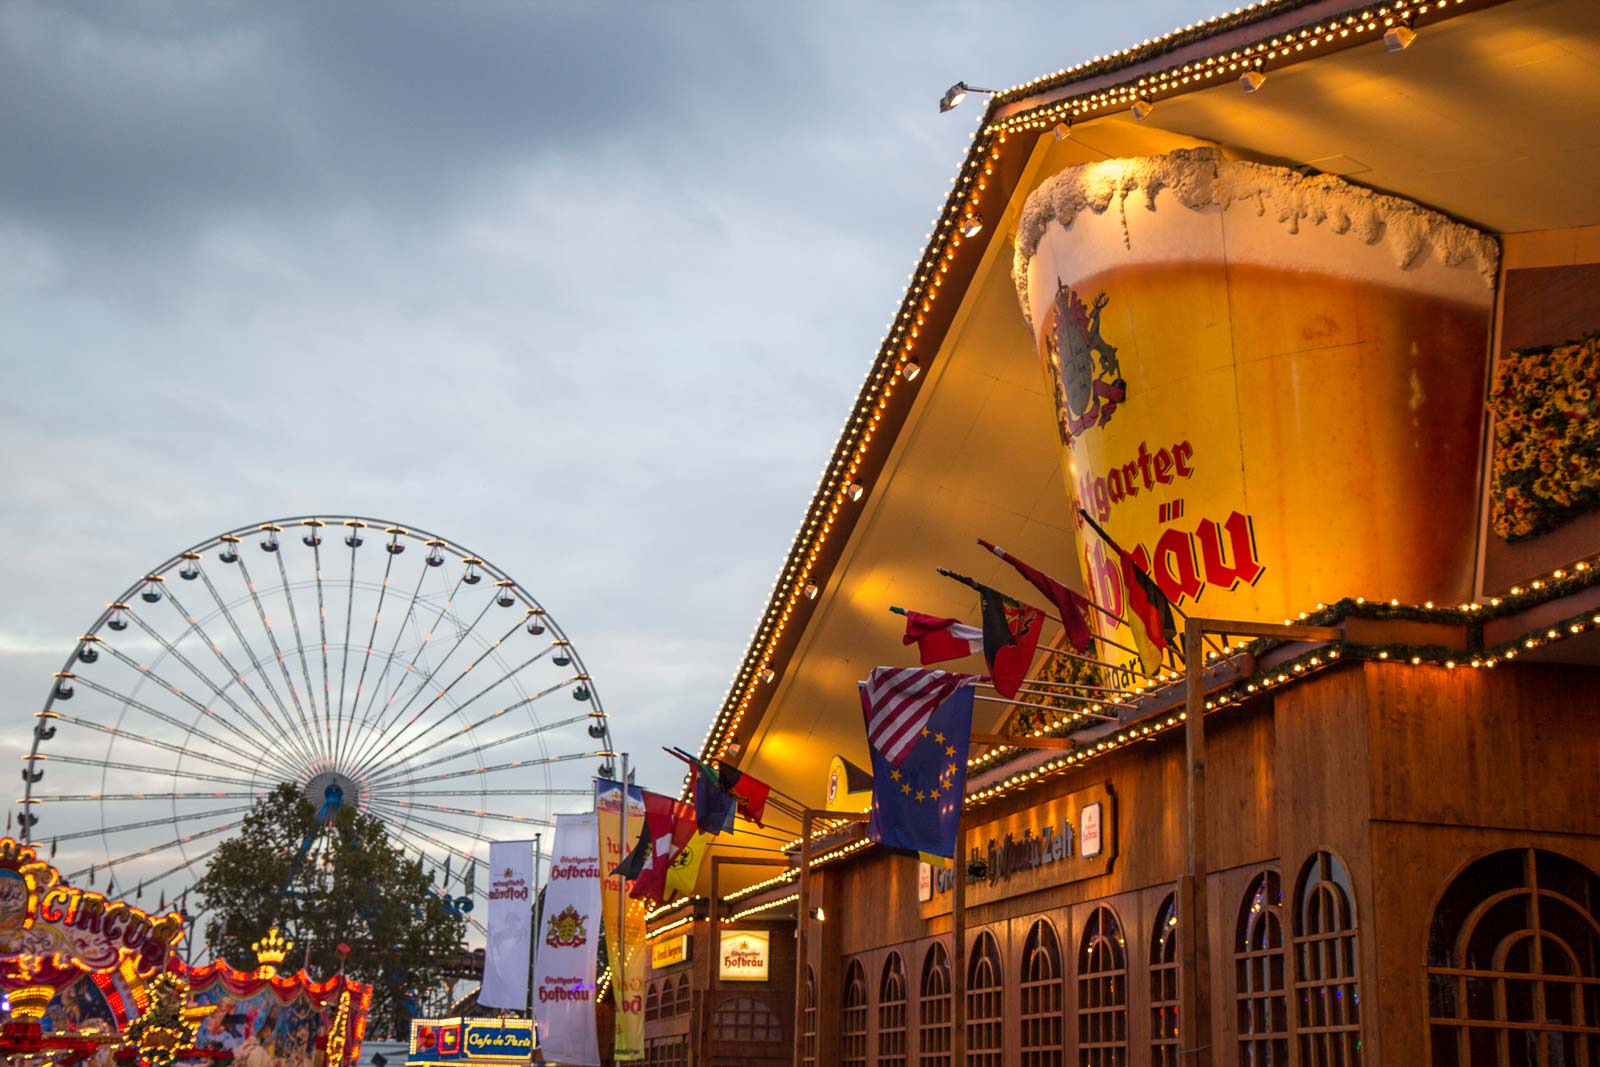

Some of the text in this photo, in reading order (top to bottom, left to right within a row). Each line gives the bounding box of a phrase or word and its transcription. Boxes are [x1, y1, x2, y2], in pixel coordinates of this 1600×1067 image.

[1041, 817, 1075, 864] Zelt
[551, 864, 600, 880] Hofbräu
[41, 889, 178, 973] CIRCUS
[724, 956, 763, 968] Hofbräu
[538, 984, 590, 1003] Hofbräu
[503, 1034, 531, 1047] Paris
